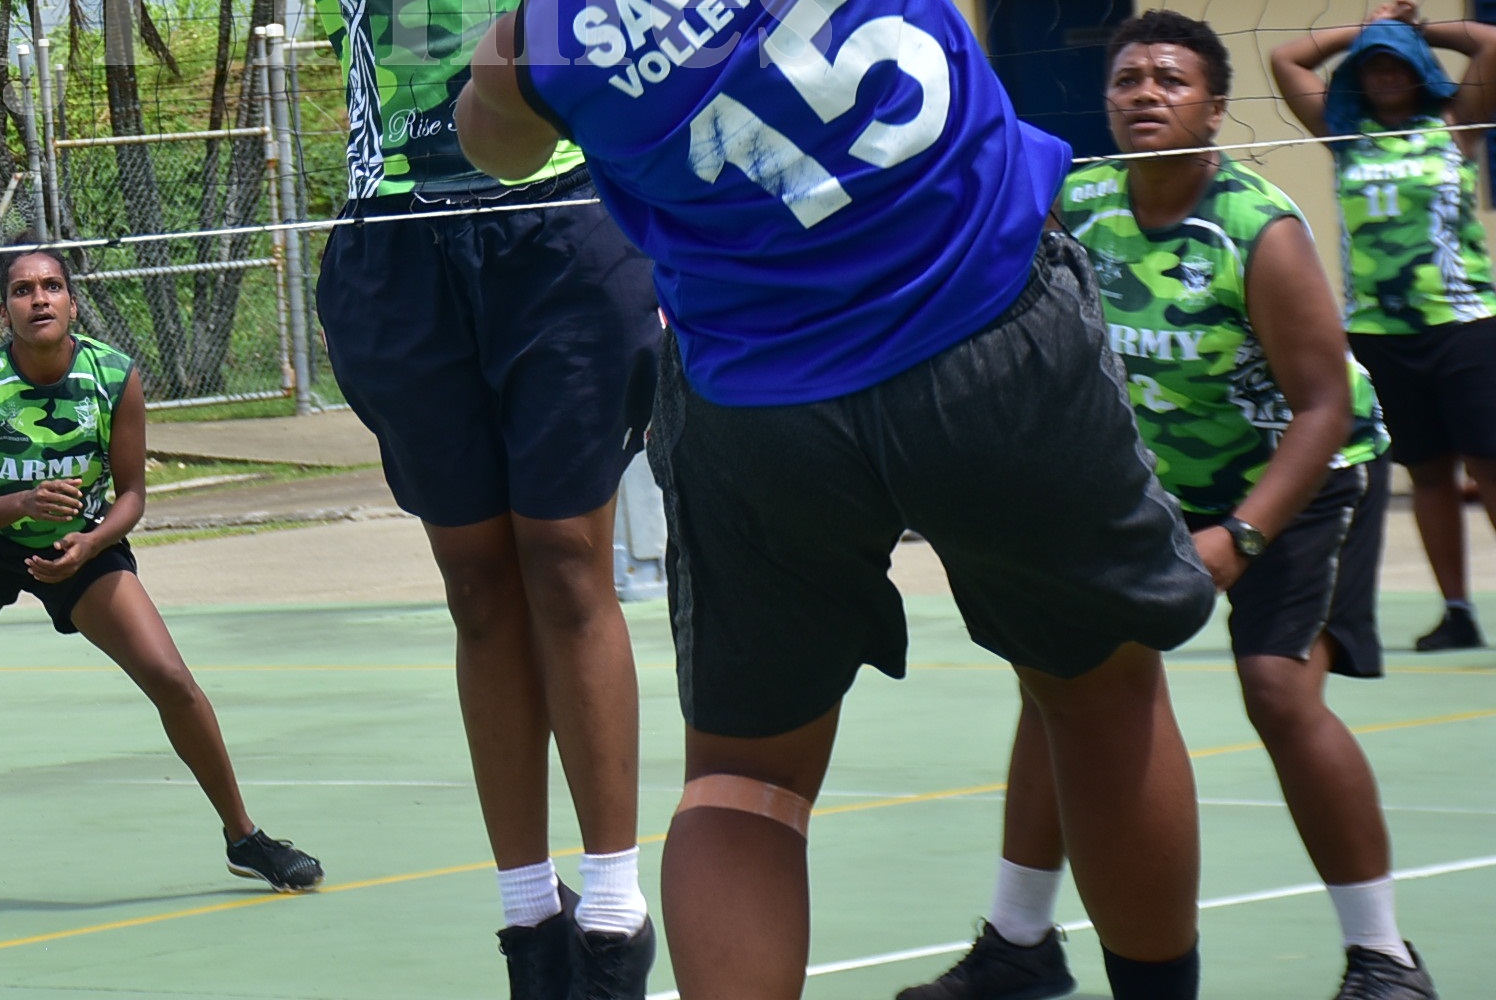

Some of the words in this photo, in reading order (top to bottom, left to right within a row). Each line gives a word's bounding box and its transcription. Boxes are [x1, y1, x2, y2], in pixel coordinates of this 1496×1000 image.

[388, 108, 442, 142] Rise
[1362, 184, 1402, 217] 11
[1106, 323, 1206, 361] RMY
